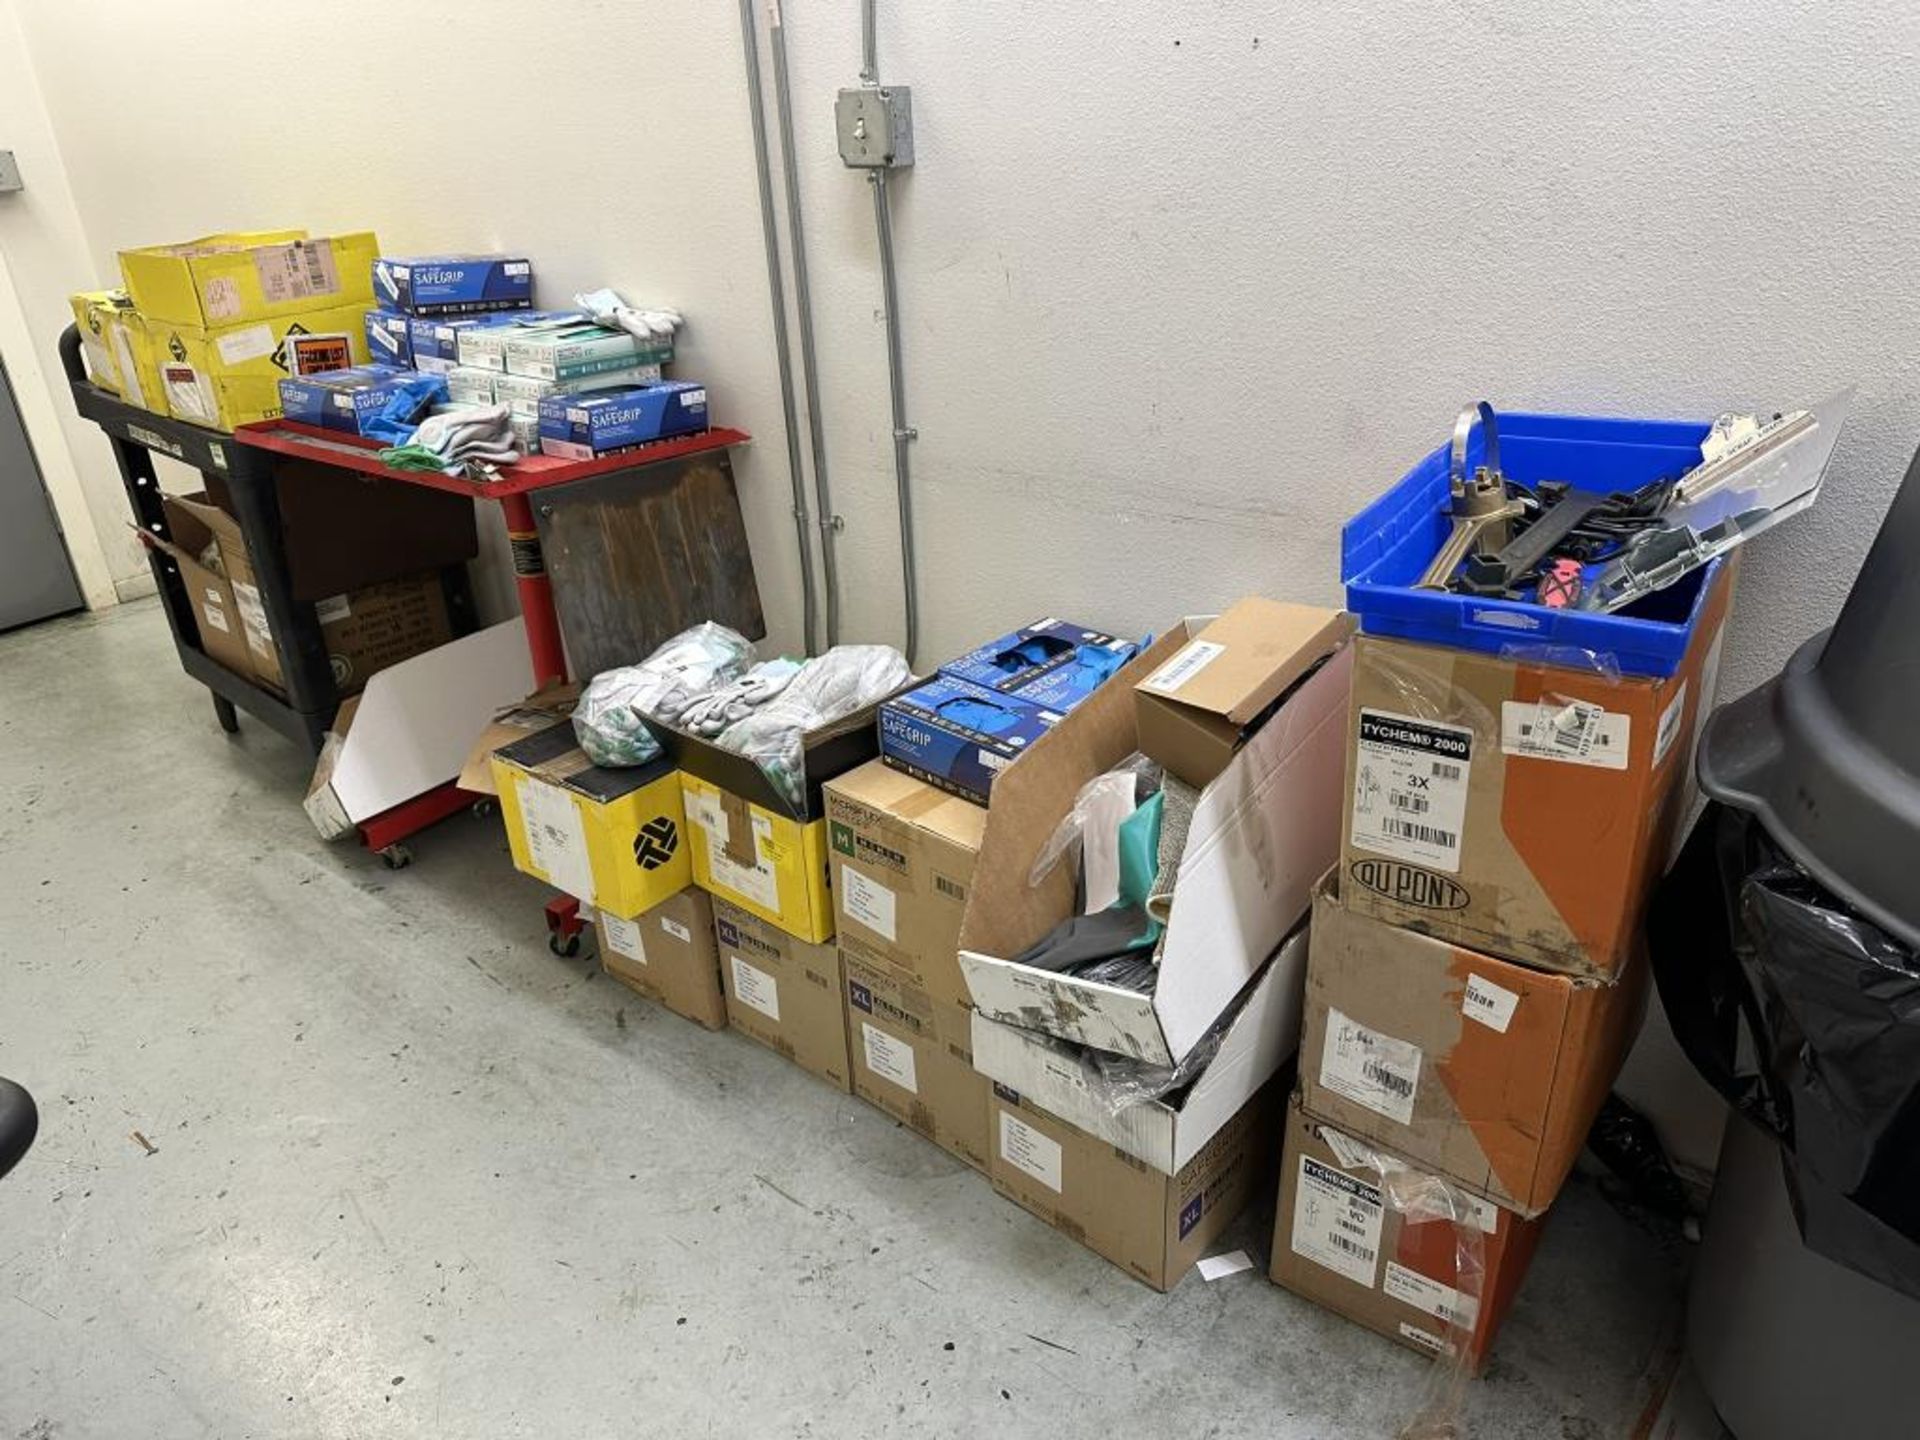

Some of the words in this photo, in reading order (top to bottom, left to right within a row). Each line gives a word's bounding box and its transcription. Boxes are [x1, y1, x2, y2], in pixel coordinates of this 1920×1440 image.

[591, 407, 642, 428] SAFEGRIP
[882, 716, 932, 747] SAFEGRIP
[1433, 737, 1467, 754] 2000
[1407, 773, 1431, 791] 3X
[836, 831, 850, 849] M
[721, 926, 737, 942] XL
[851, 987, 871, 1007] XL
